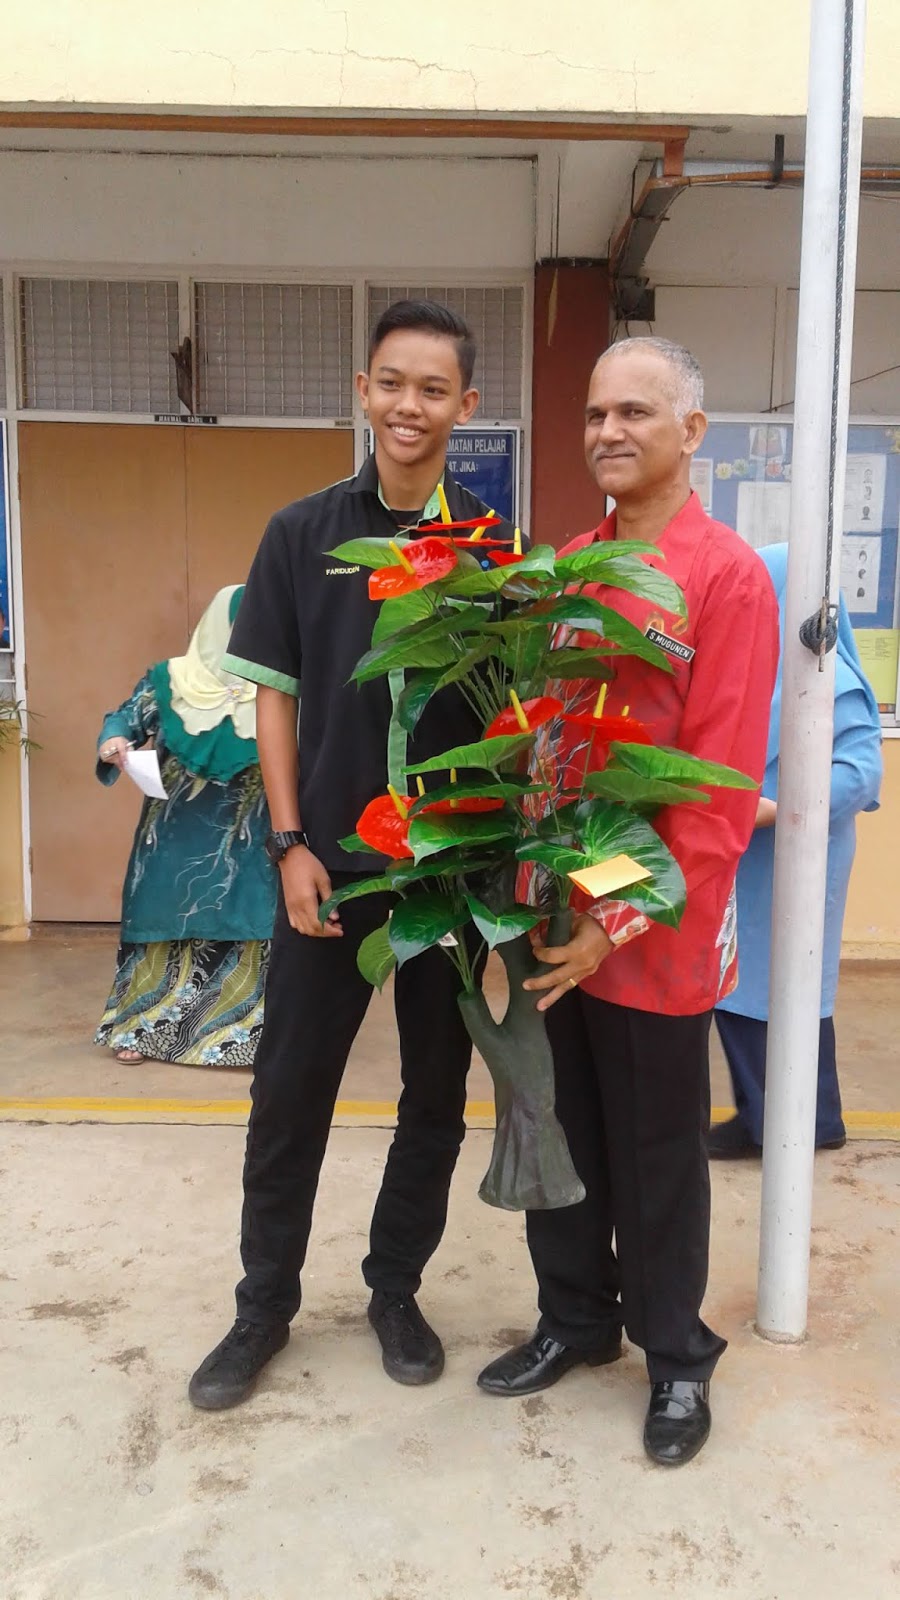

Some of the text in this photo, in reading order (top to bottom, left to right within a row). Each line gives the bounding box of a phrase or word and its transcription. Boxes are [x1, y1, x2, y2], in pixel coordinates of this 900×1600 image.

[447, 438, 507, 453] MATAN PELAJAR
[459, 461, 479, 472] JIKA:
[648, 632, 690, 658] S.MUGUNEN
